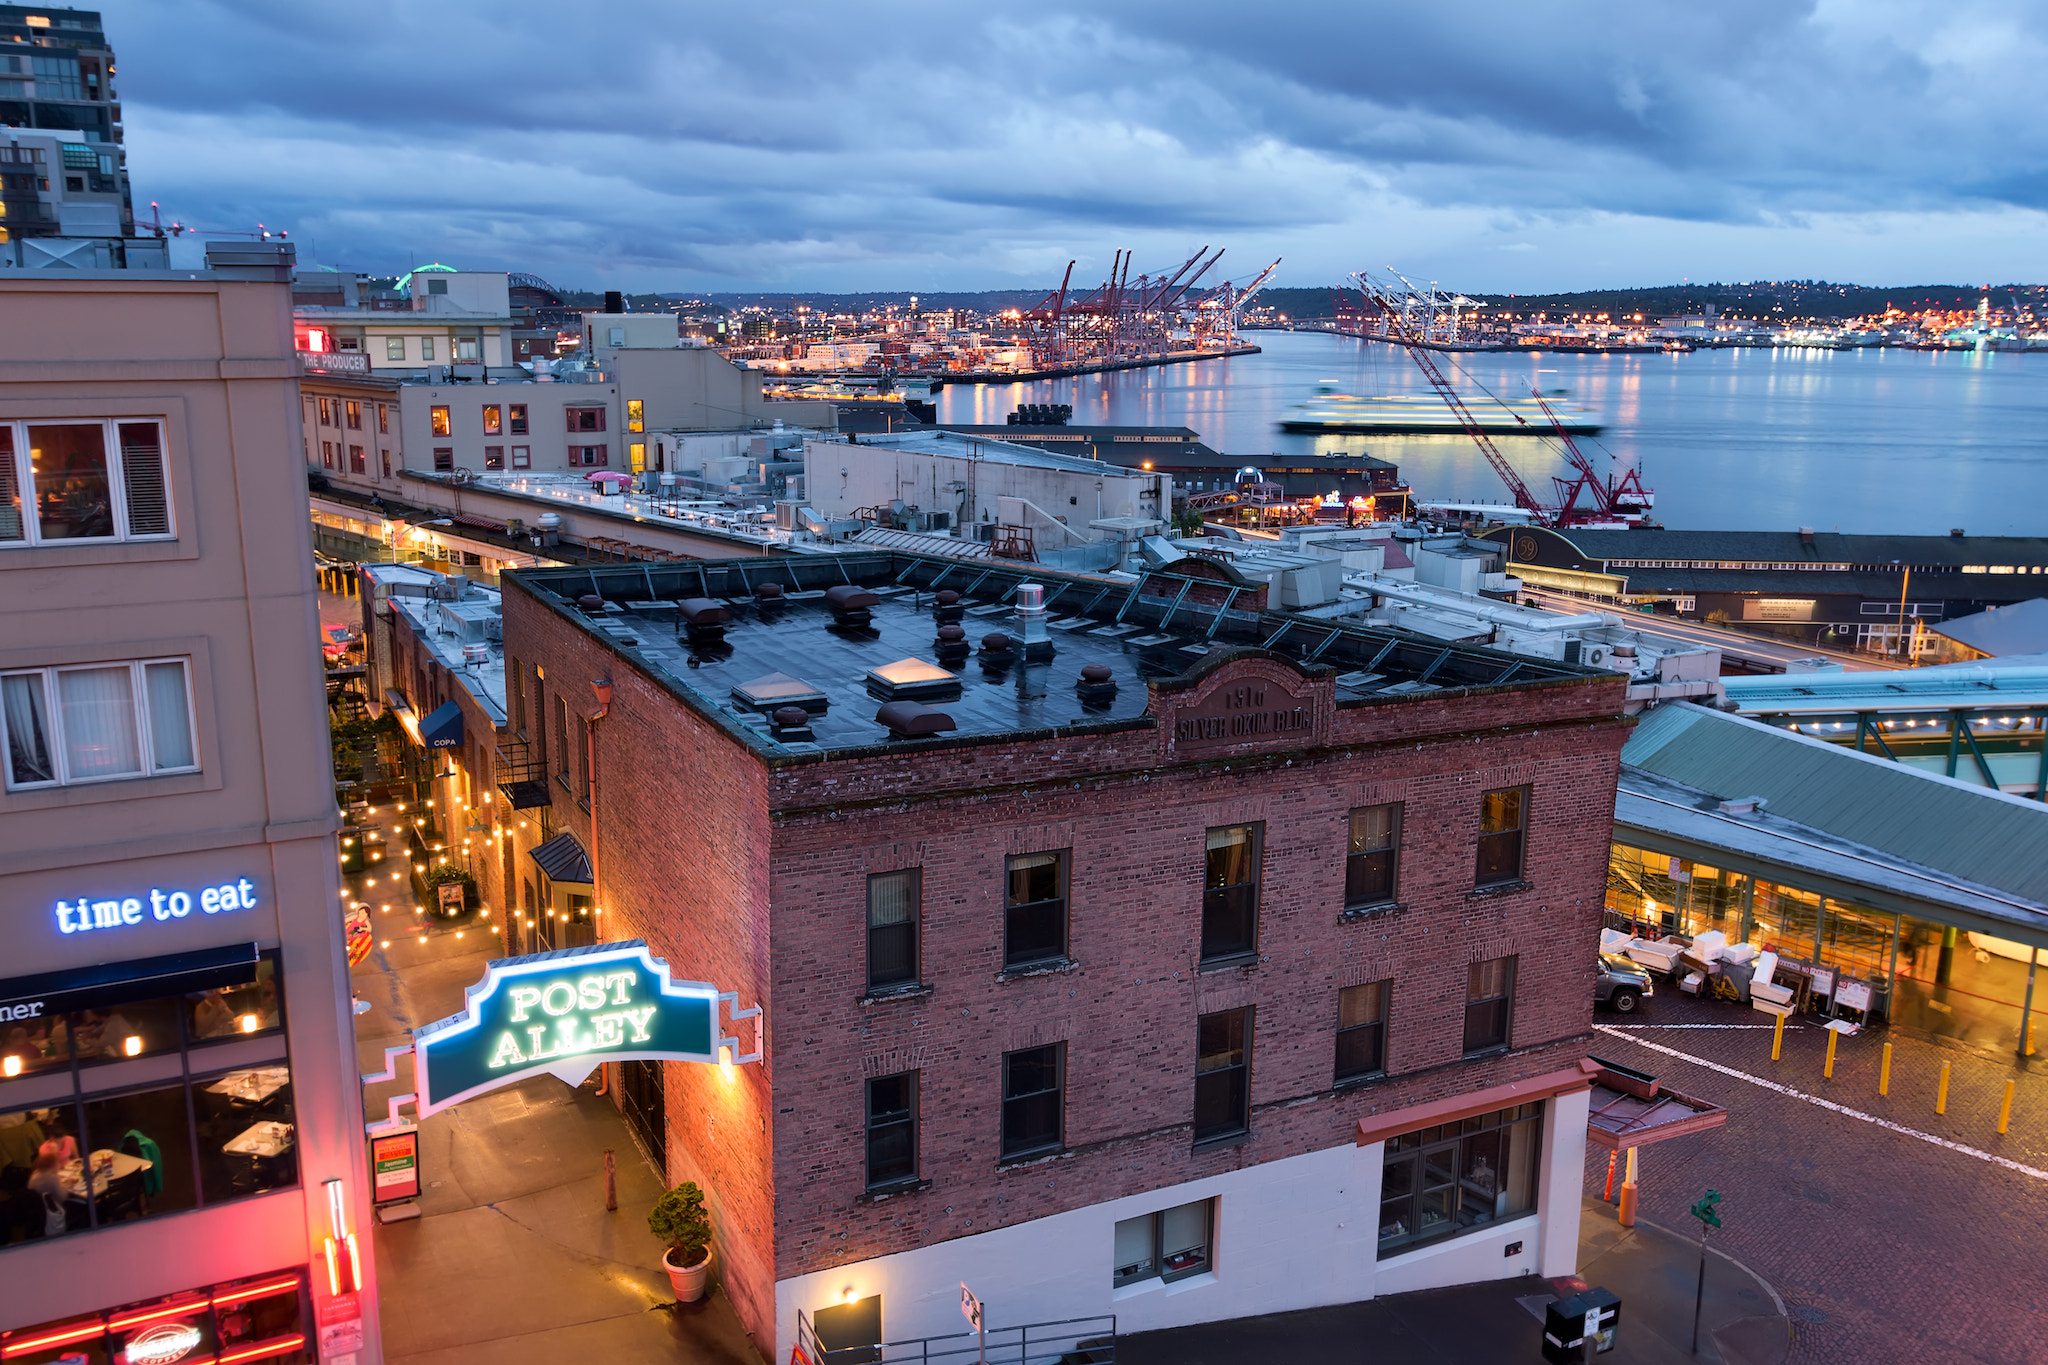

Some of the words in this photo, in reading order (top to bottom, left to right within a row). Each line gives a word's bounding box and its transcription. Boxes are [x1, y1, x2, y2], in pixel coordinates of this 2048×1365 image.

[303, 353, 319, 367] THE
[322, 355, 366, 370] PRODUCER
[1520, 540, 1535, 556] 59
[1226, 687, 1263, 708] 1910
[55, 897, 144, 934] time
[149, 888, 192, 921] to
[200, 877, 257, 914] eat
[1811, 968, 1832, 978] PARKING
[1838, 980, 1847, 988] NO
[510, 971, 637, 1023] POST
[489, 1006, 657, 1068] ALLEY
[143, 1349, 185, 1364] COFFEE
